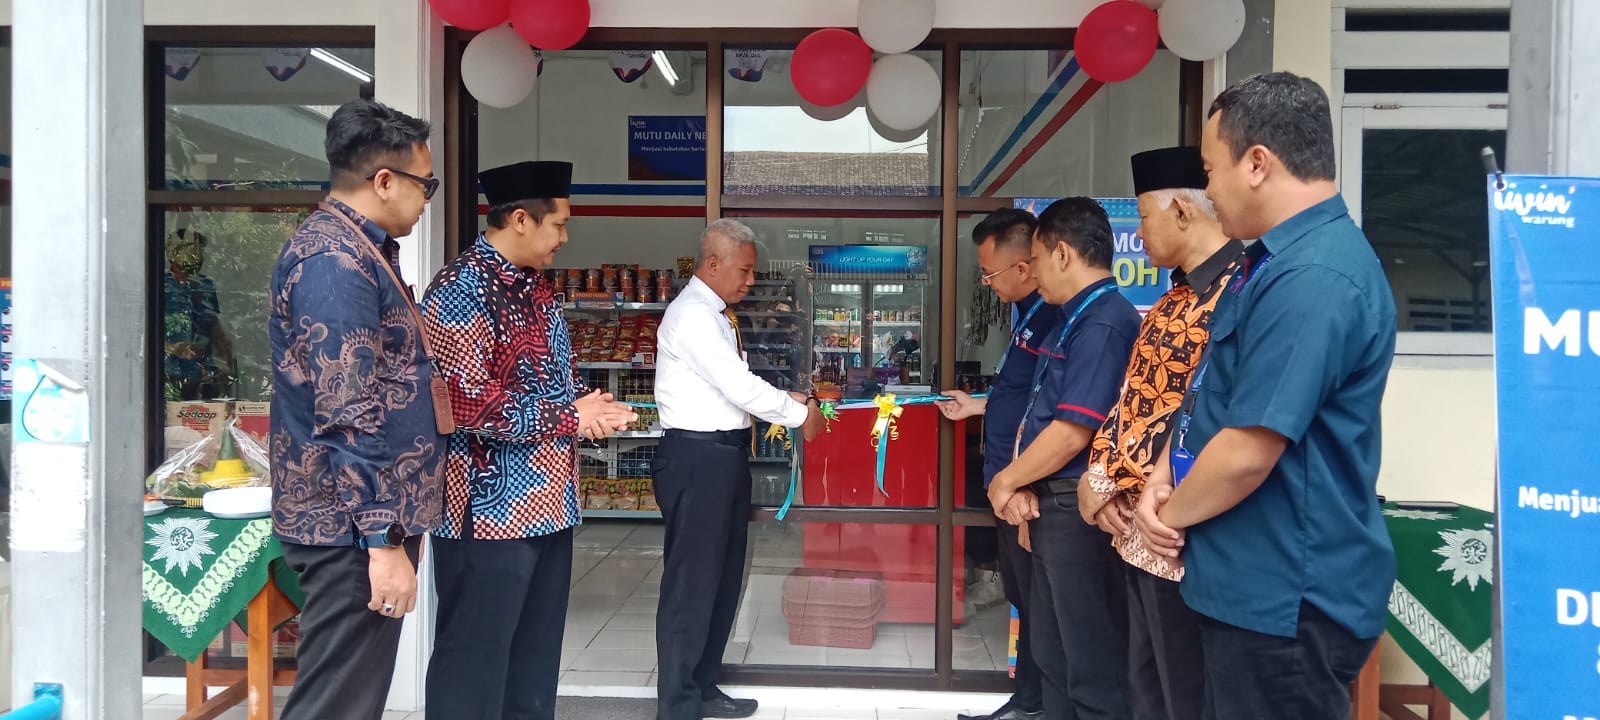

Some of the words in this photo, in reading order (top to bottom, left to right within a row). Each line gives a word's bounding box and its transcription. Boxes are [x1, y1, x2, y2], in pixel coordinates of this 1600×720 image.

[634, 131, 662, 140] MUTU
[664, 131, 692, 140] DAILY
[1521, 215, 1575, 228] warung
[1523, 306, 1600, 357] M
